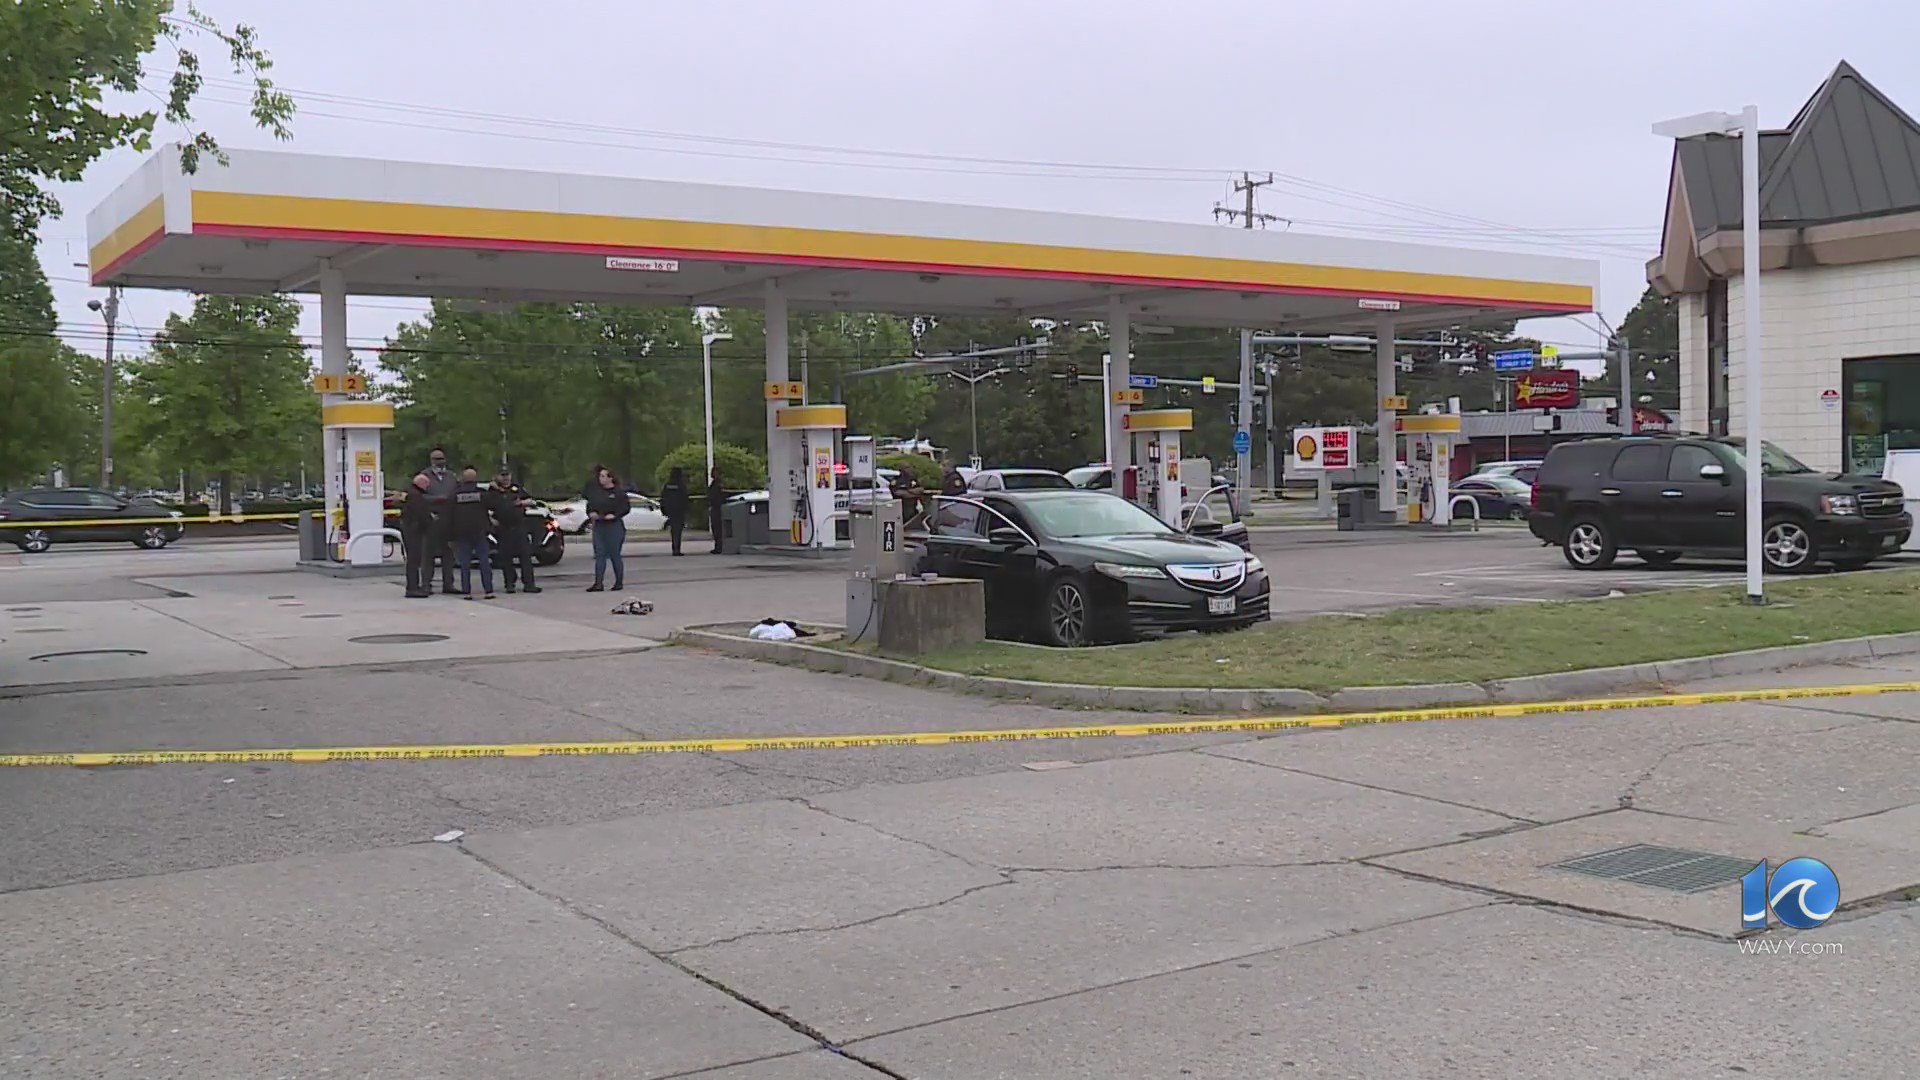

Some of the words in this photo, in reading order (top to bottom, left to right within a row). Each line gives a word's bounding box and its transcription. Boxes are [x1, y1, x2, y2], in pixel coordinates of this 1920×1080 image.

[610, 260, 651, 269] Clearance
[324, 378, 330, 389] 1
[347, 378, 356, 389] 2
[772, 385, 779, 395] 3
[790, 385, 798, 394] 4
[858, 456, 869, 464] AIR
[885, 523, 893, 550] AIR
